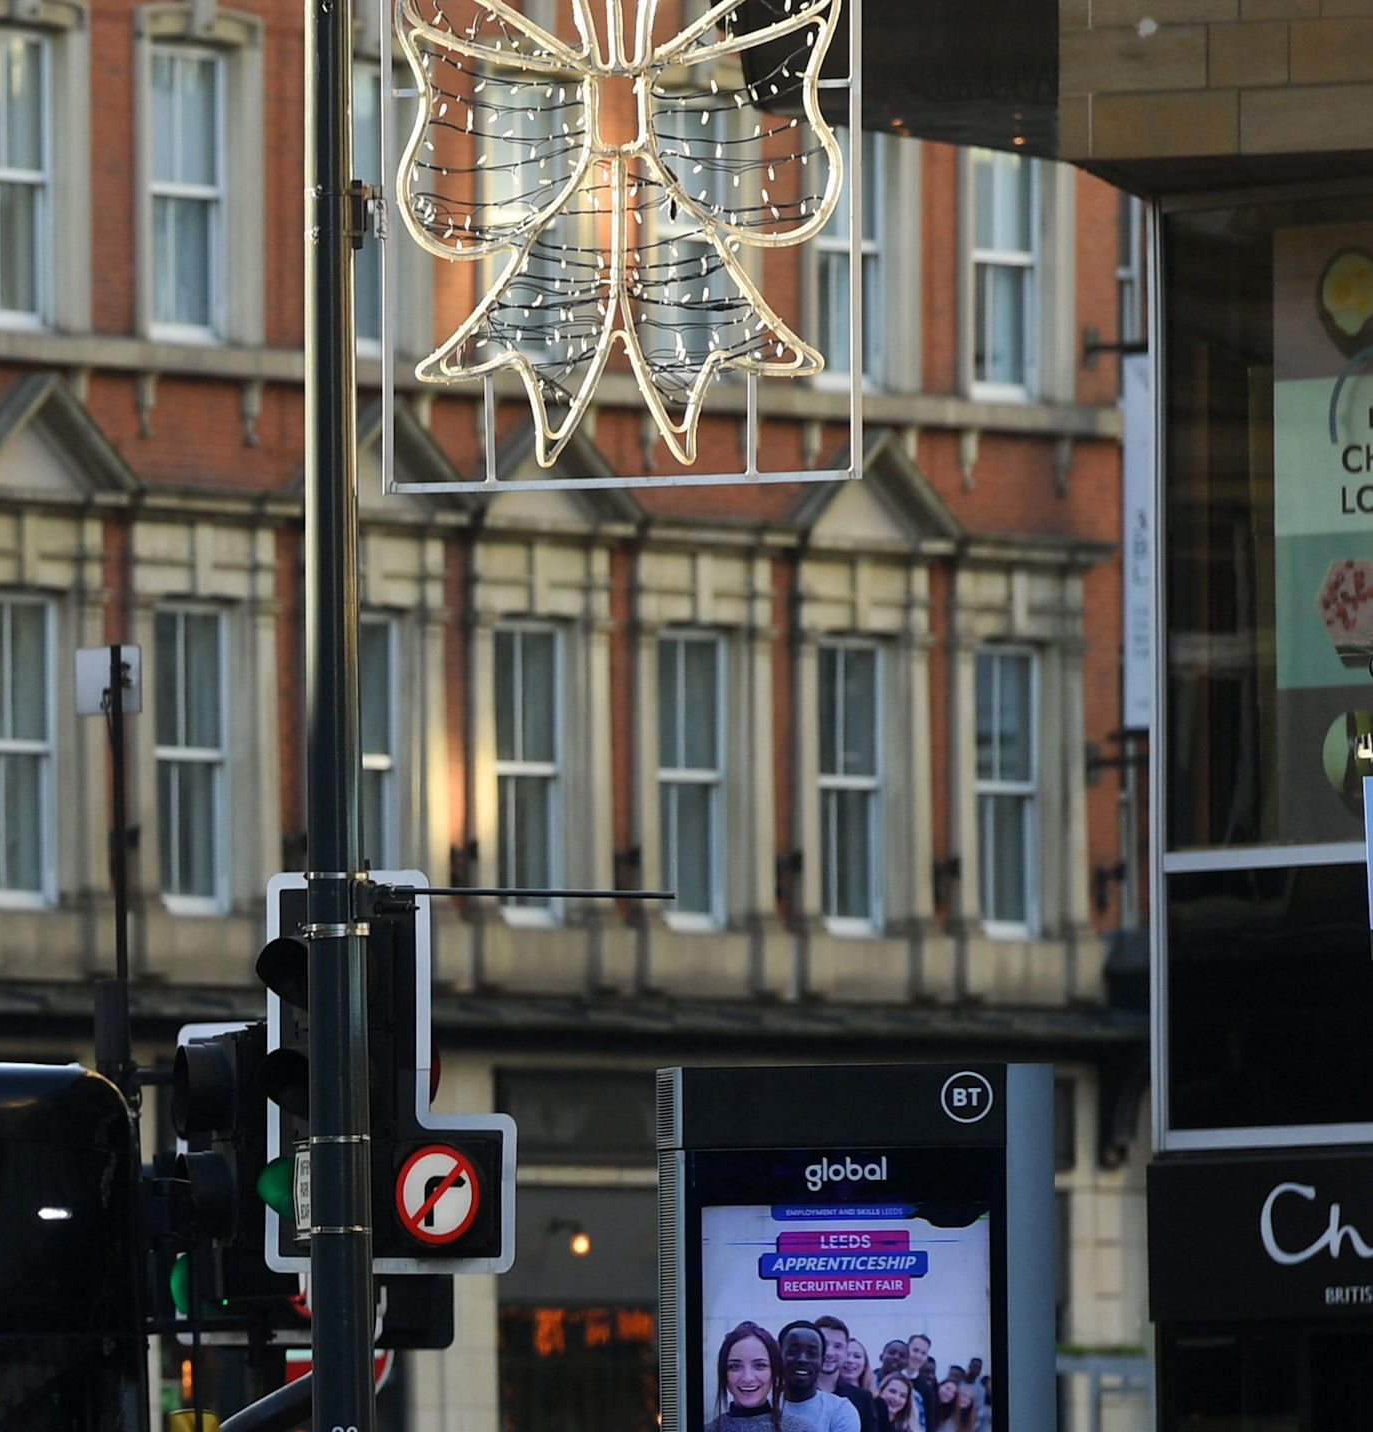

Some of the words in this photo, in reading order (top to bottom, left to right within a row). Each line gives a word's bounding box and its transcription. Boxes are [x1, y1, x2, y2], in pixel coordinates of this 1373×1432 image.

[952, 1088, 982, 1107] BT
[805, 1156, 887, 1191] global
[785, 1208, 837, 1217] EMPLOYMENT
[838, 1208, 855, 1216] AND
[857, 1208, 880, 1216] SKILLS
[881, 1207, 903, 1215] LEEDS
[820, 1235, 872, 1249] LEEDS
[772, 1256, 917, 1272] APPRENTICESHIP
[784, 1280, 873, 1292] RECRUITMENT
[876, 1279, 903, 1291] FAIR
